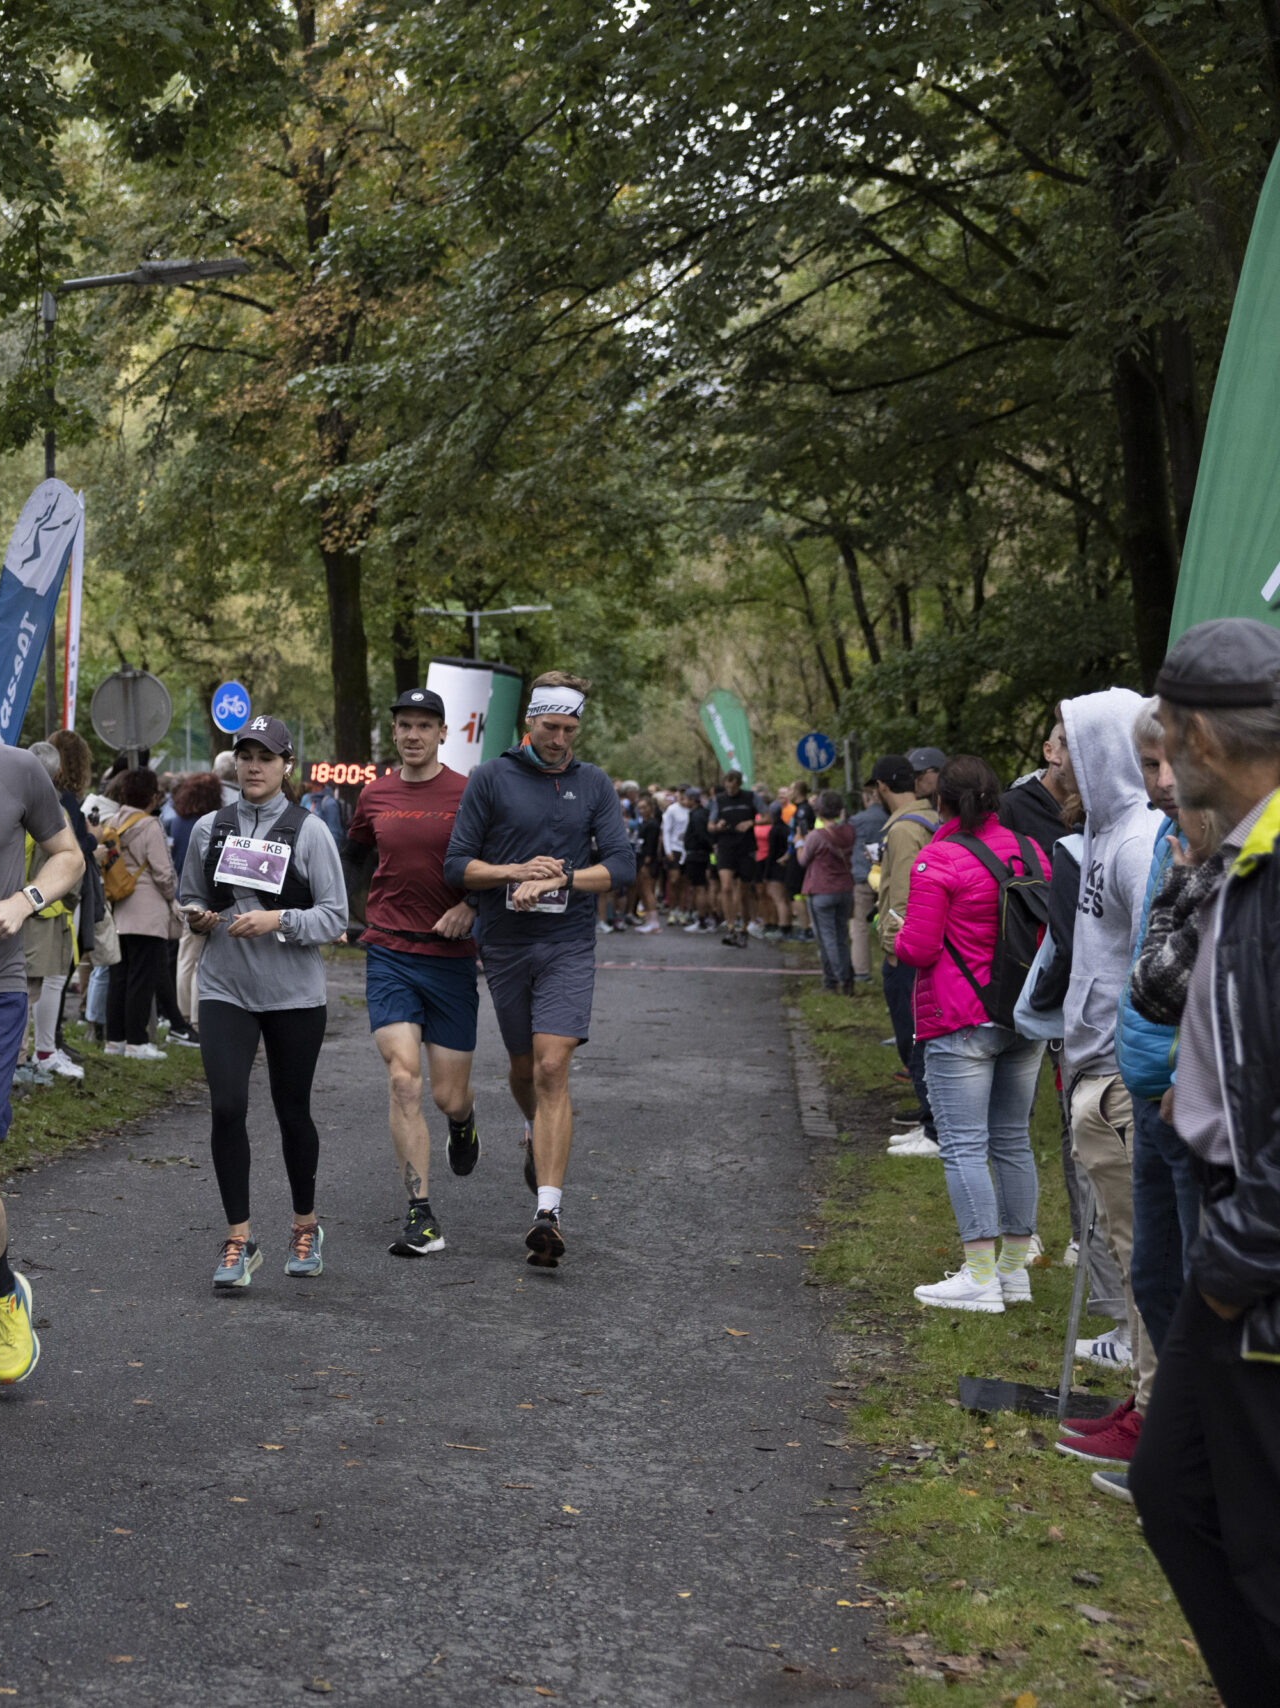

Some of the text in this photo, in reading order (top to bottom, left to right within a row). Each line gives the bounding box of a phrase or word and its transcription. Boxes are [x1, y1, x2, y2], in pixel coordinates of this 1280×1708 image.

[250, 716, 268, 732] LA
[310, 762, 392, 785] 18:00:5
[232, 838, 251, 849] iKB
[262, 843, 283, 855] iKB
[258, 860, 269, 874] 4
